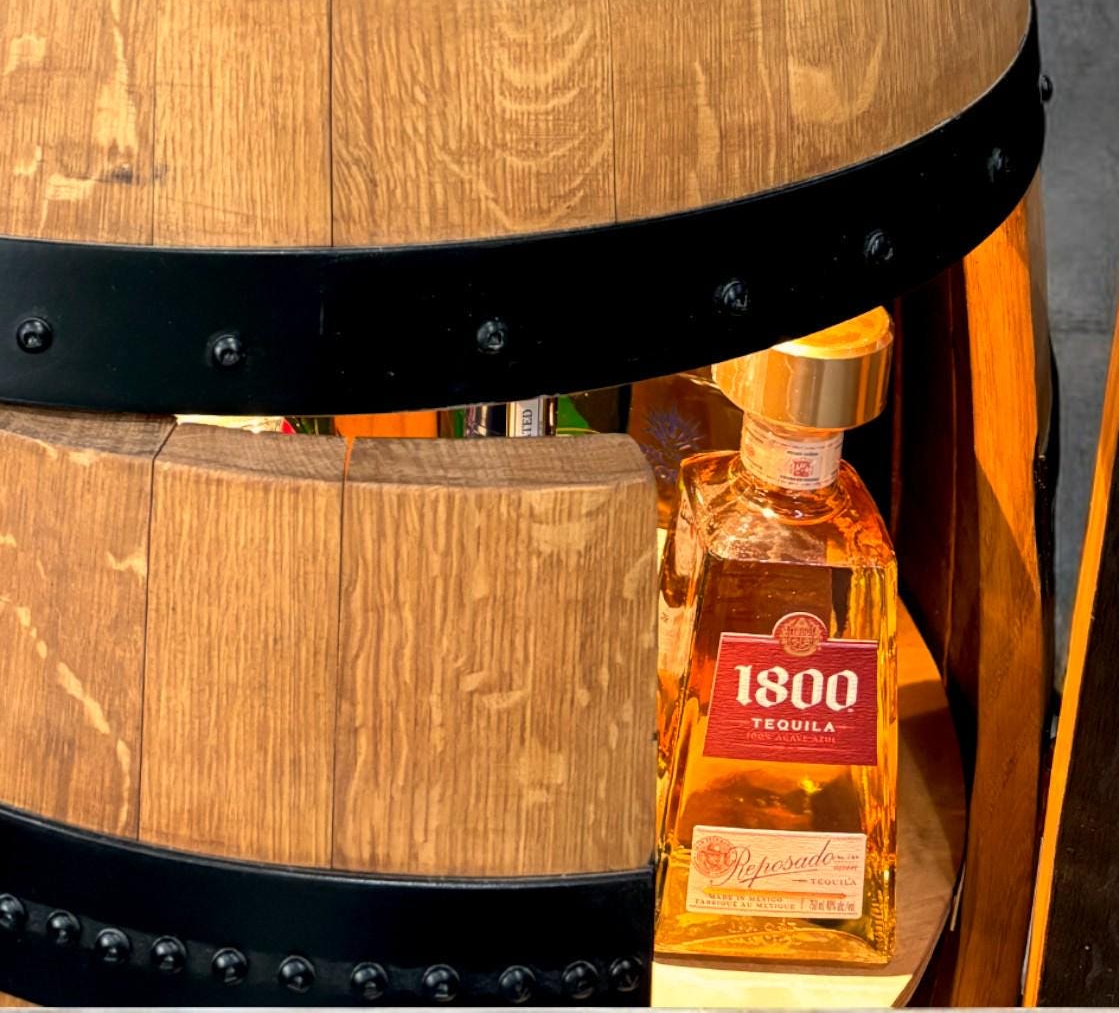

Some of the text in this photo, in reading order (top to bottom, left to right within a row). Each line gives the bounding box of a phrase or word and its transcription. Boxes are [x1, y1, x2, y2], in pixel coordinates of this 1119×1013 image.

[521, 409, 533, 437] TED
[734, 664, 859, 712] 1800
[751, 717, 836, 733] TEQUILA
[709, 840, 835, 888] Reposado
[809, 877, 857, 886] TEQUILA
